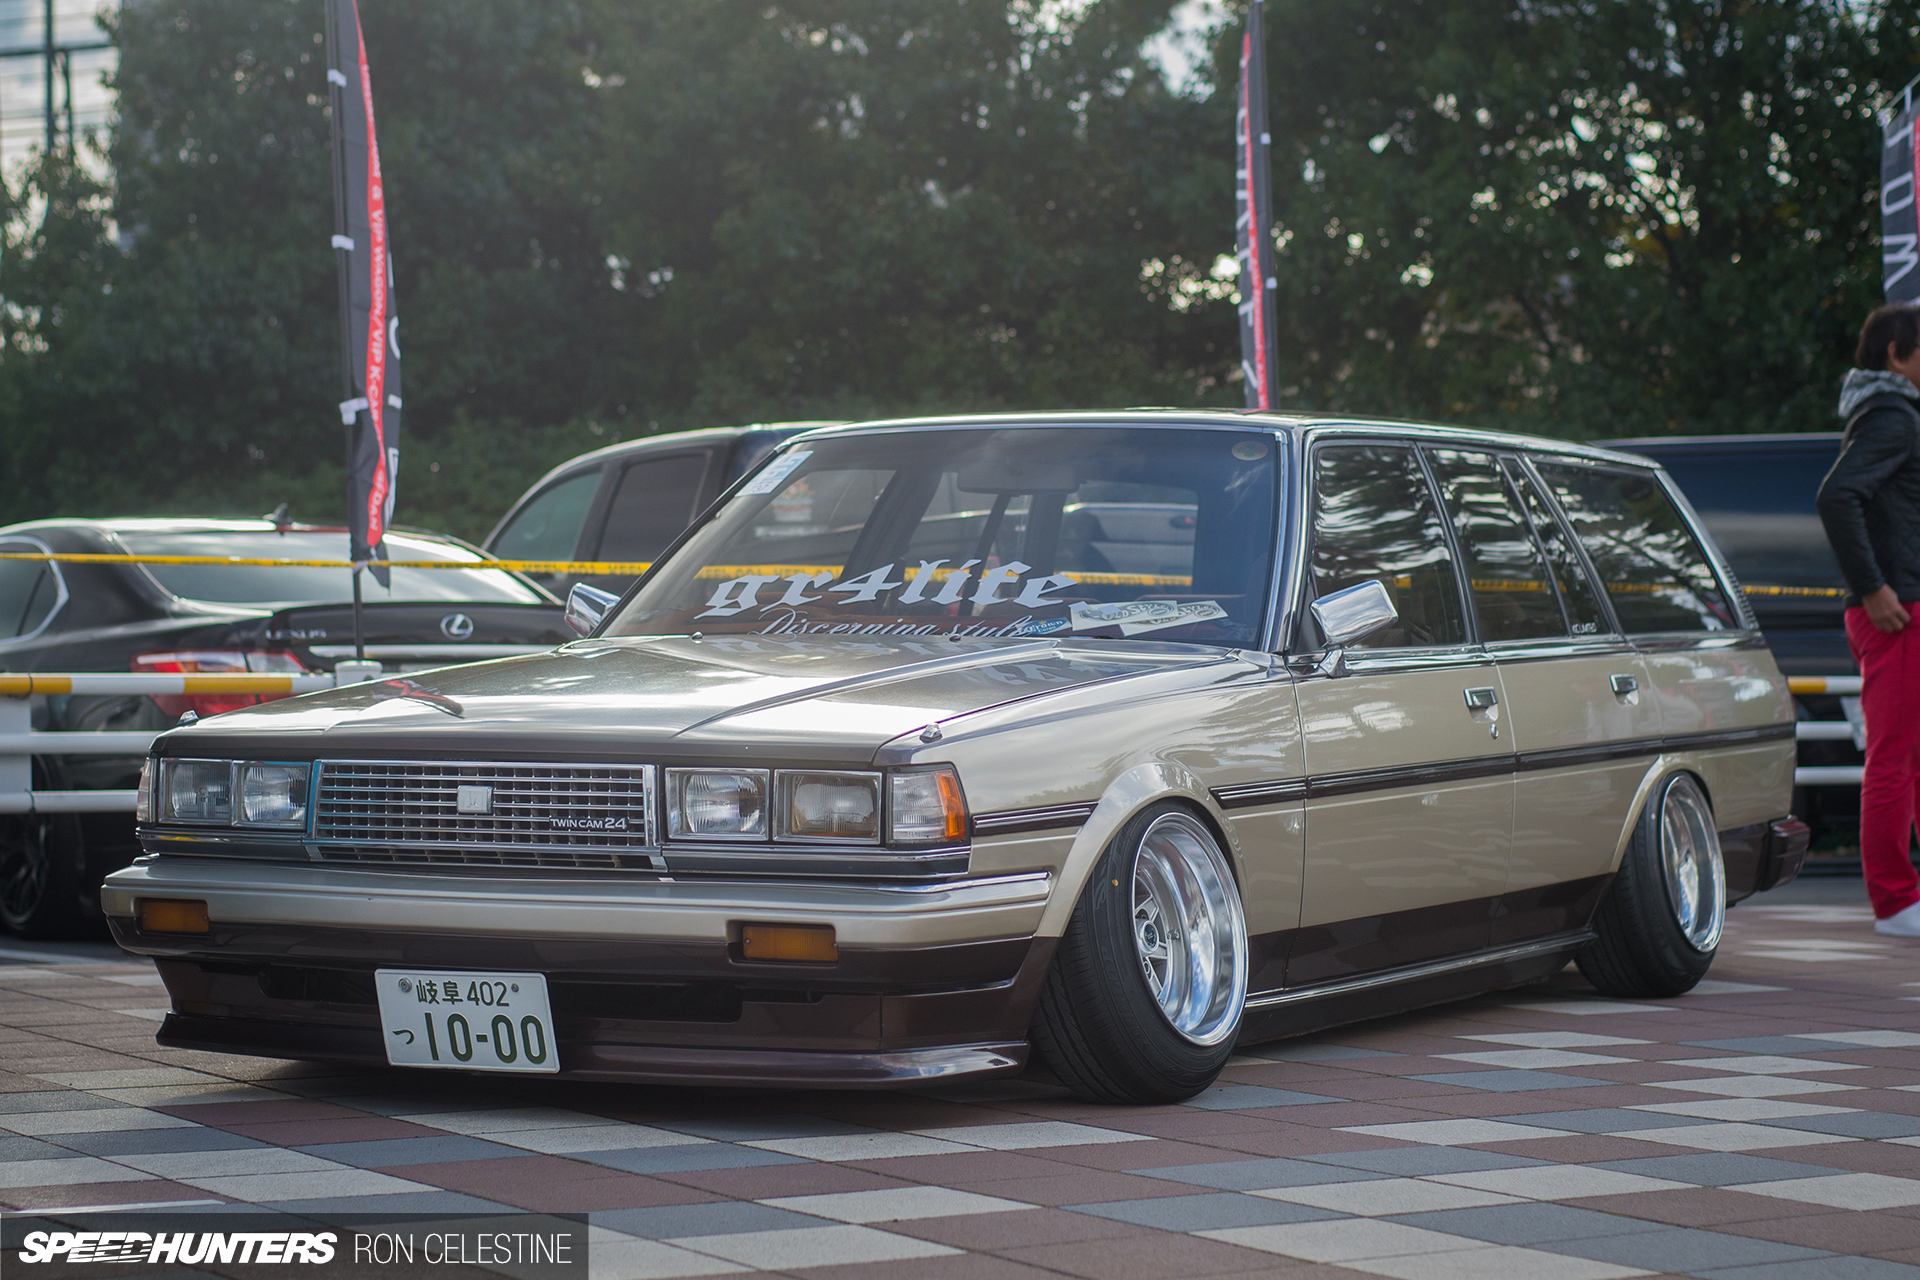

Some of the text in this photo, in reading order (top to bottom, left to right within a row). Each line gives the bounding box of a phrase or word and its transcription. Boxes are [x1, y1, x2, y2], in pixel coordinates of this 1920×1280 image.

[371, 209, 384, 243] VIP
[550, 817, 627, 829] TWIN CAM 24
[392, 1012, 547, 1065] つ 10-00
